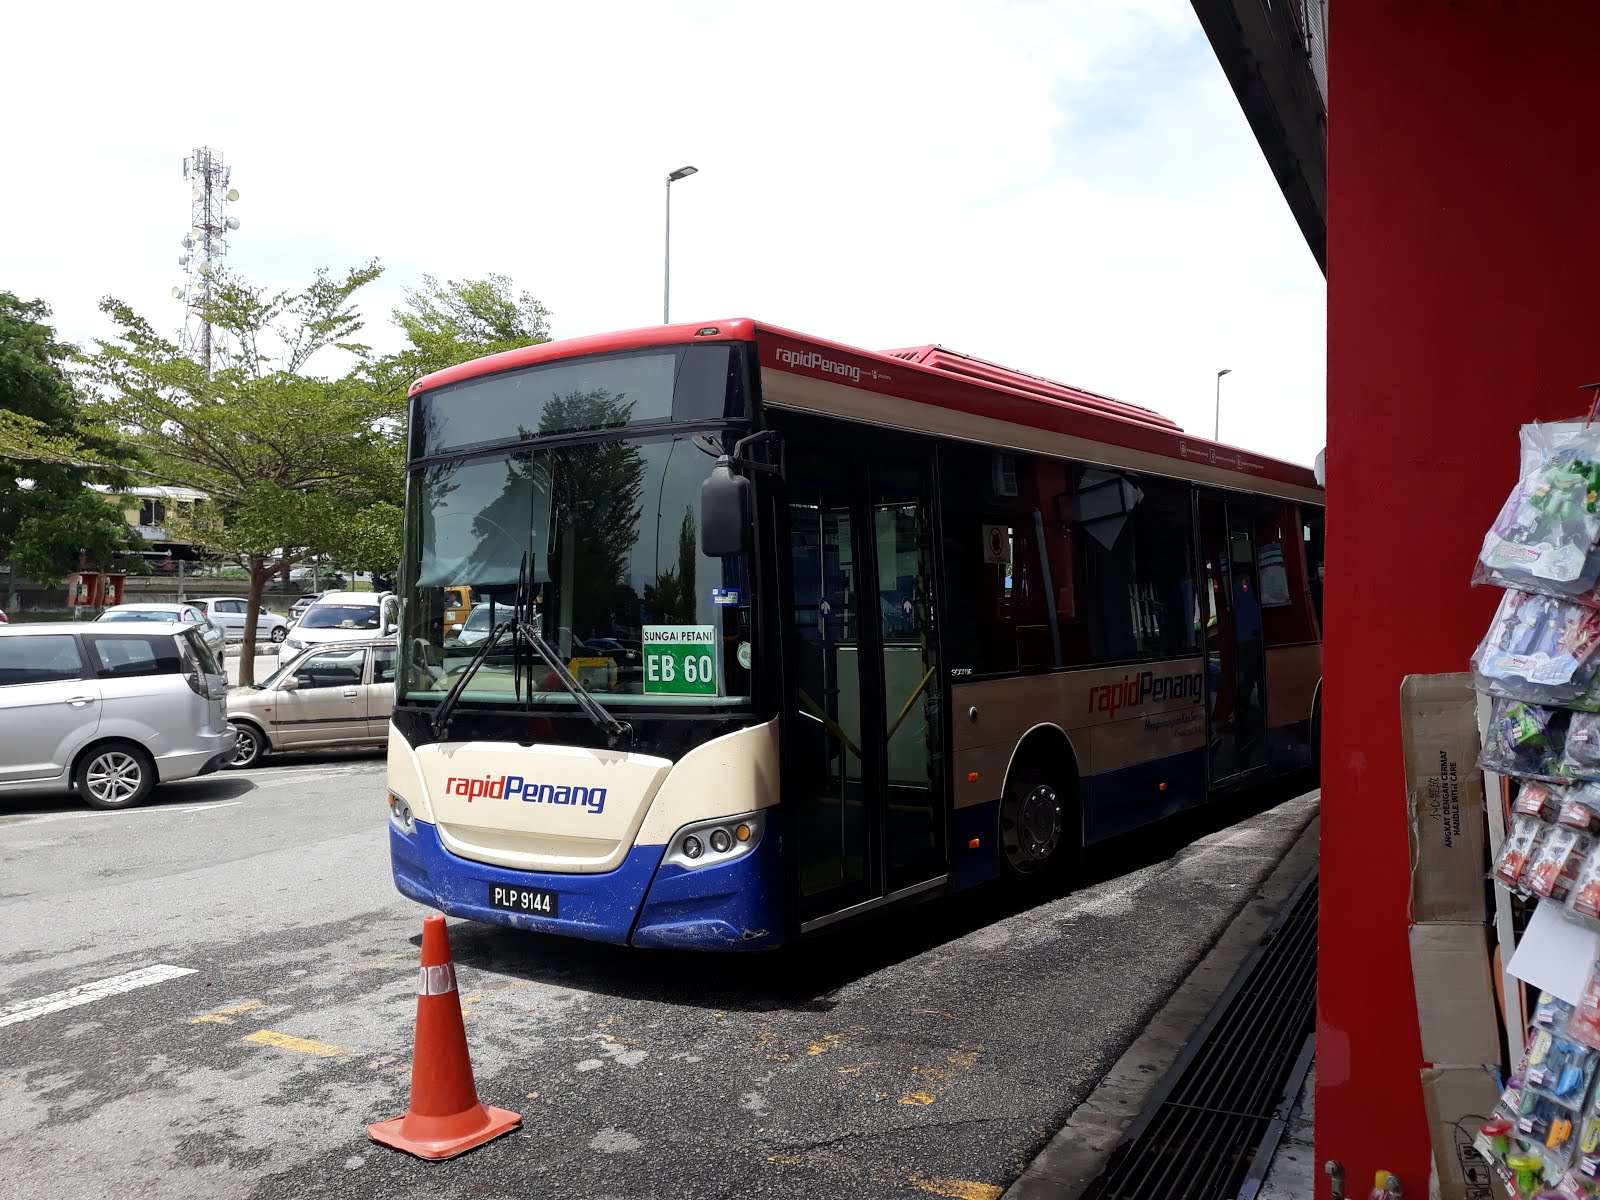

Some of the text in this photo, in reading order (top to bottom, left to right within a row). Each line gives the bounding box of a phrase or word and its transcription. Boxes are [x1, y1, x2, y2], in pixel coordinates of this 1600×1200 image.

[775, 347, 862, 382] rapidPenang
[644, 631, 713, 643] SUNGAI PETANI
[647, 654, 713, 683] EB 60
[1088, 670, 1203, 719] rapidPenang
[445, 774, 608, 814] rapidPenang
[1440, 750, 1452, 848] ANGKAT DENGAN CERMAT
[1452, 805, 1460, 836] HANDLE
[494, 887, 551, 912] PLP 9144
